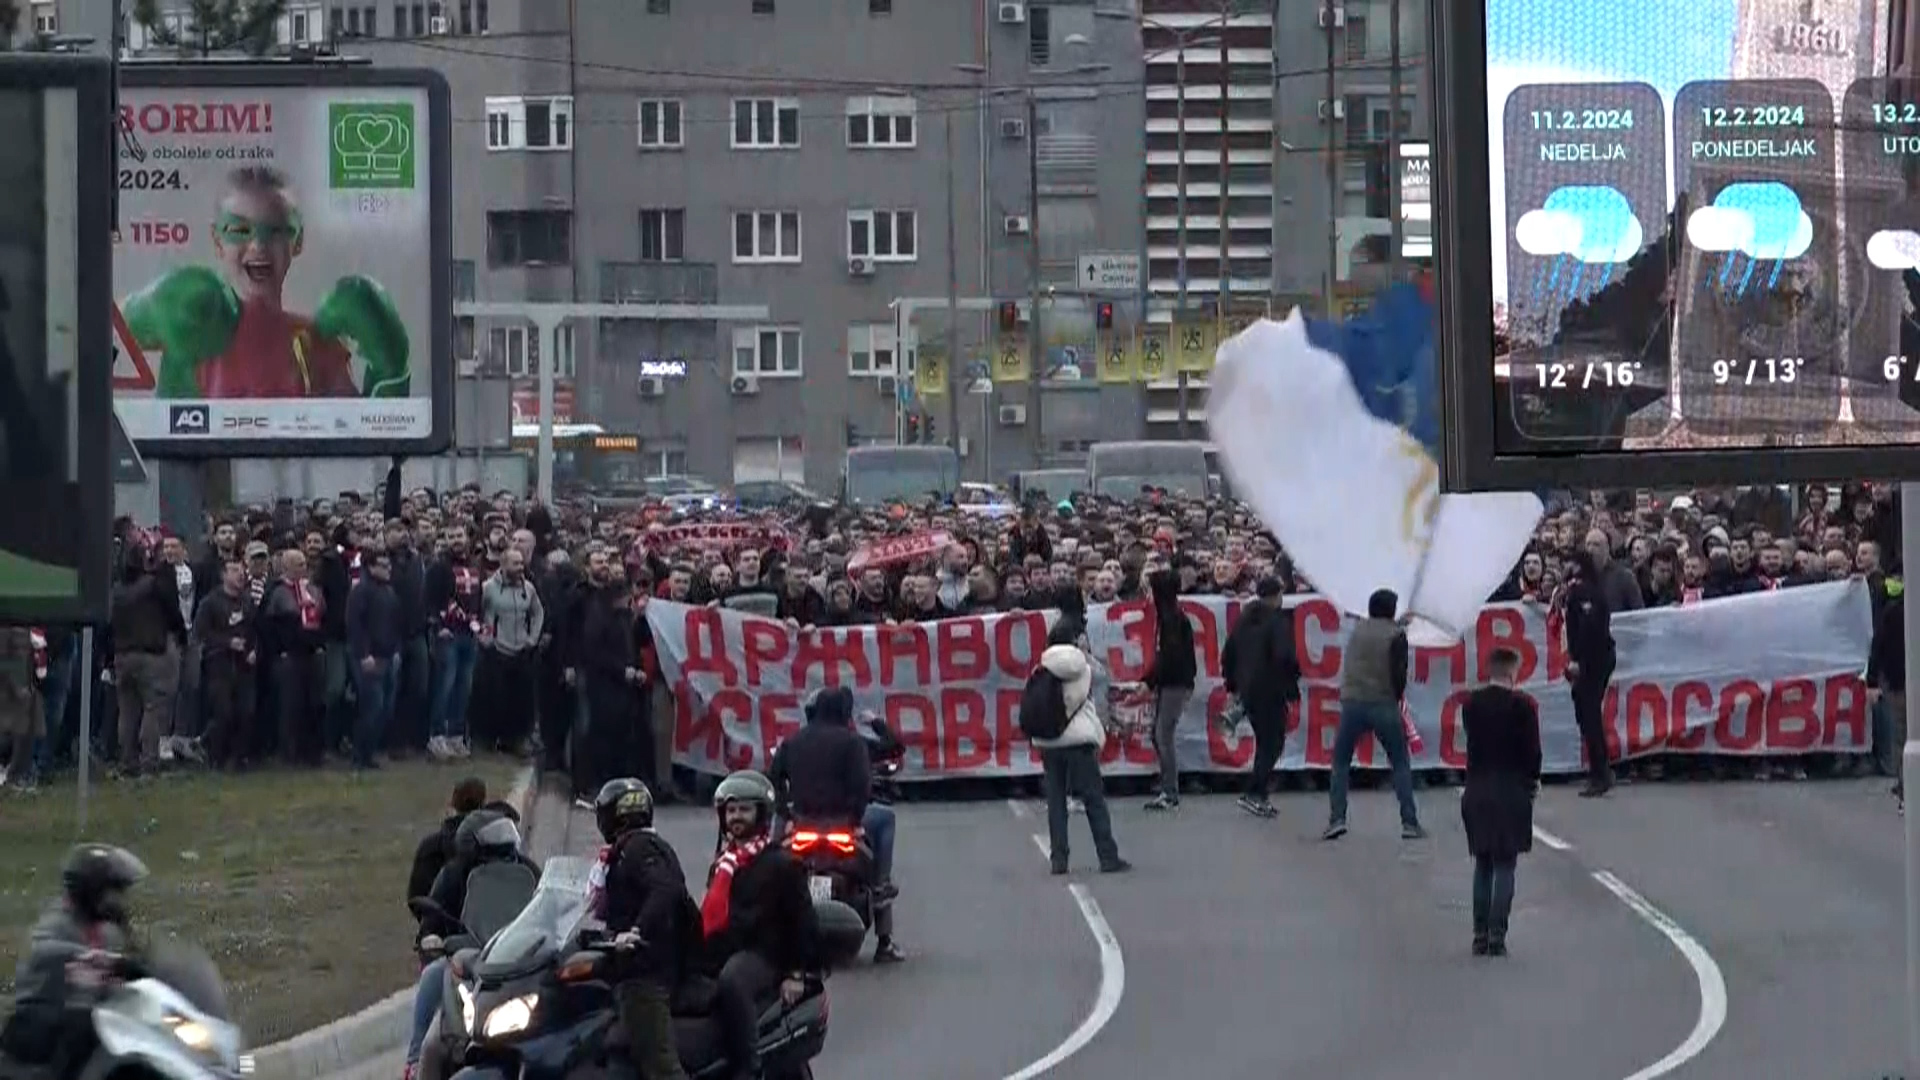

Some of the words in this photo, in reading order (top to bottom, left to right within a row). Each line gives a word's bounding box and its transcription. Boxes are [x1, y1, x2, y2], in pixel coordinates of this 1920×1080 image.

[1531, 109, 1634, 130] 11.2.2024
[1702, 106, 1805, 127] 12.2.2024
[152, 145, 212, 159] obolele
[215, 145, 236, 159] od
[239, 145, 275, 159] raka
[1540, 143, 1627, 161] NEDELJA
[1691, 138, 1817, 158] PONEDELJAK
[119, 169, 189, 190] 2024.
[130, 222, 189, 244] 1150
[683, 606, 1048, 690] ДРЖАВО
